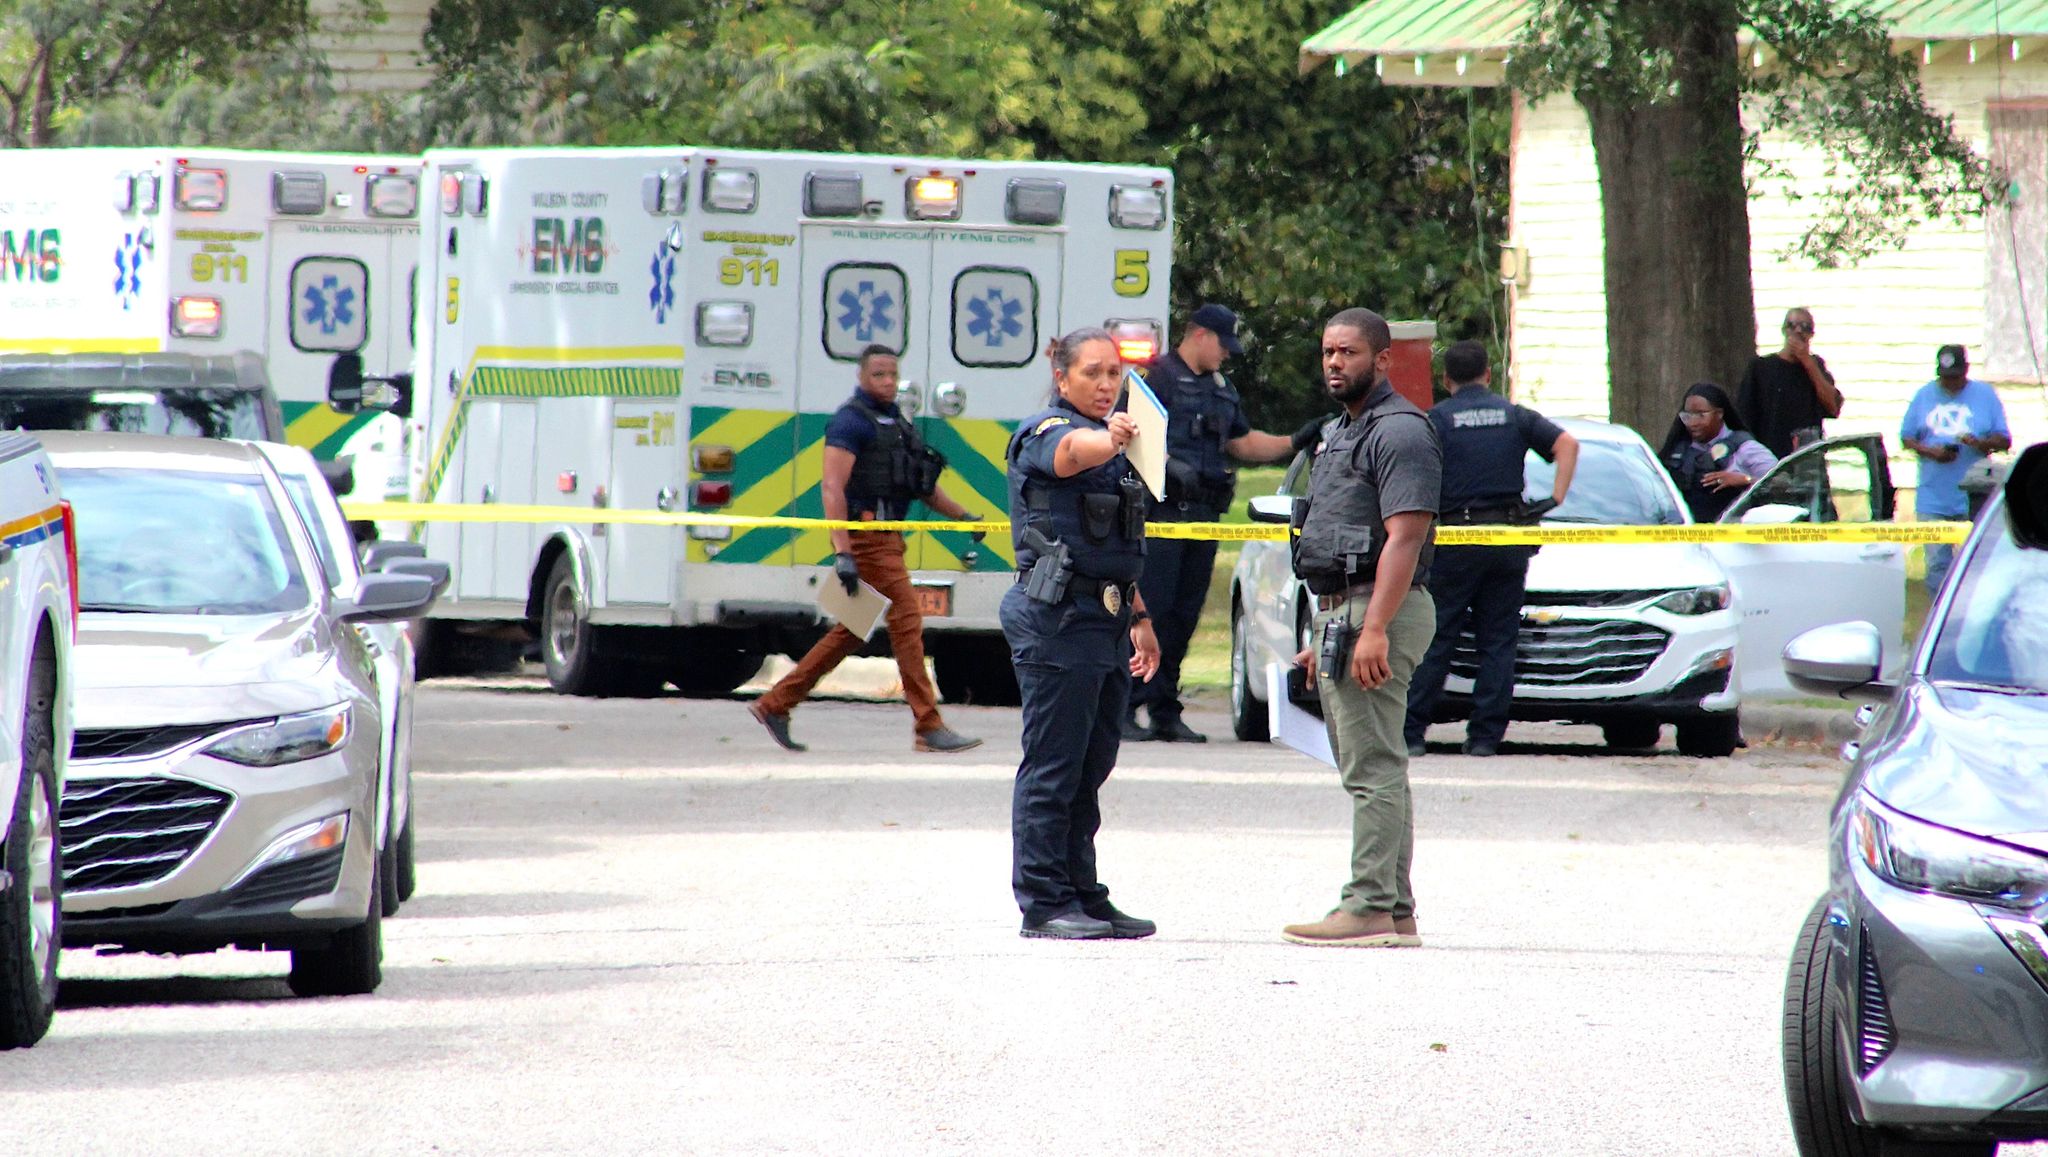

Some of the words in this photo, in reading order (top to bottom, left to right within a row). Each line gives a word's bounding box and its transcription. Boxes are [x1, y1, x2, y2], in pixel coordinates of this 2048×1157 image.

[571, 192, 608, 208] COUNTY
[0, 228, 61, 282] MS
[532, 217, 604, 273] EMS
[190, 253, 248, 283] 911
[719, 258, 779, 286] 911
[1111, 249, 1150, 298] 5
[447, 276, 459, 325] 5
[714, 370, 772, 388] EMS
